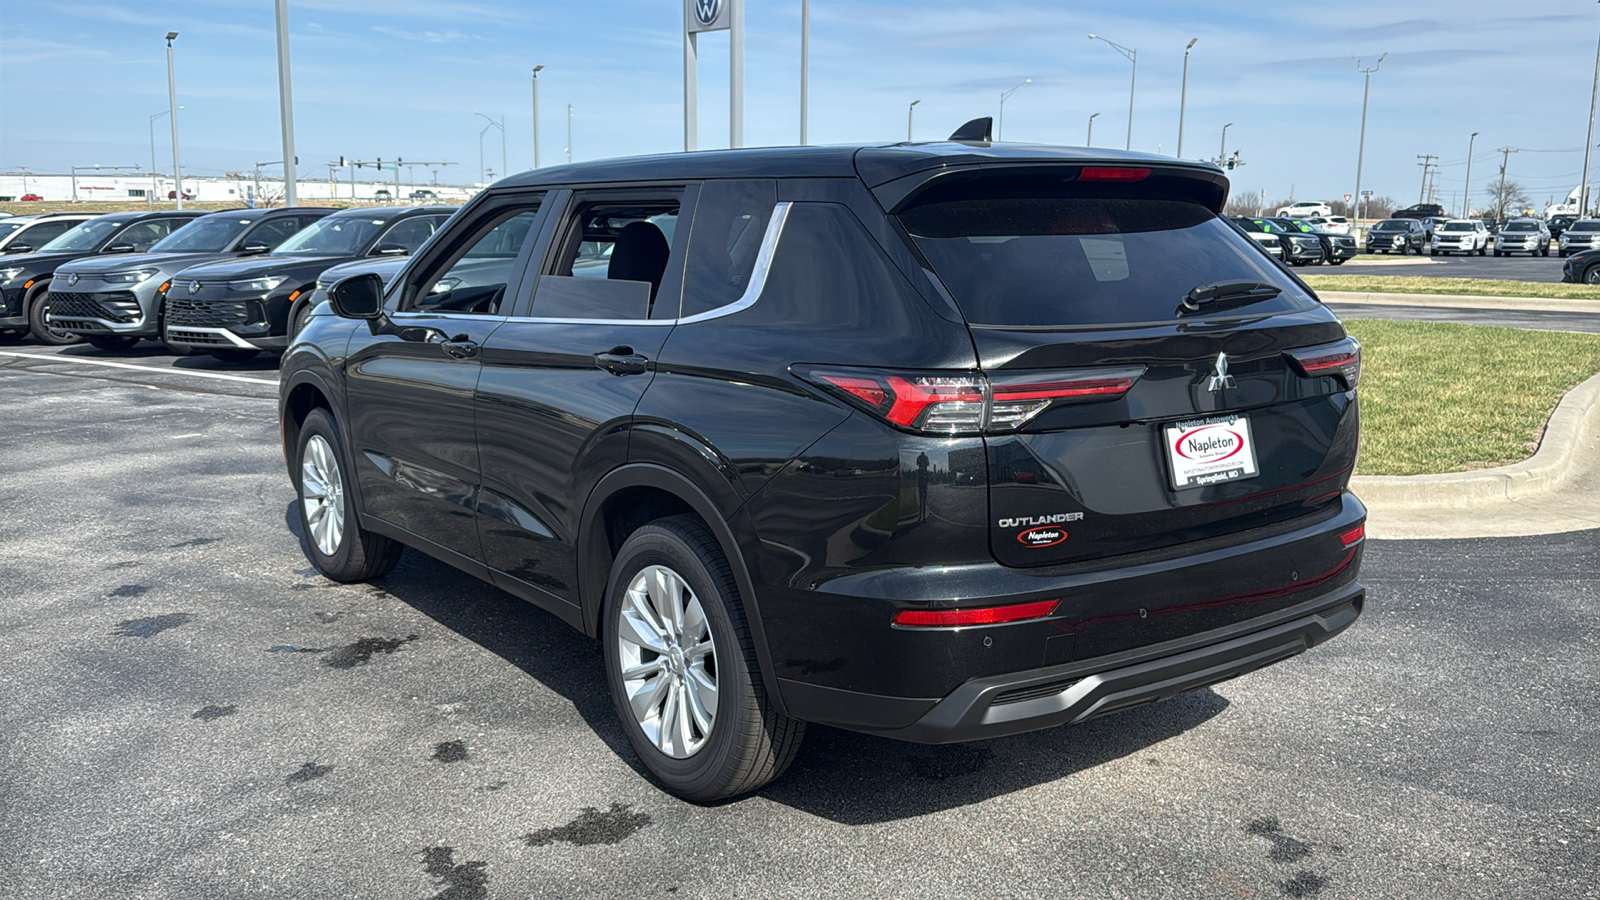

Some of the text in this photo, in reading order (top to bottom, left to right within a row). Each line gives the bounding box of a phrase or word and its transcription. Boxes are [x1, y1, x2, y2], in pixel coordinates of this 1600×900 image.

[1176, 419, 1204, 429] Napleton
[1188, 437, 1234, 453] Napleton
[1196, 470, 1239, 484] Springfield, MO
[998, 511, 1084, 528] OUTLANDER
[1028, 530, 1059, 540] Napleton
